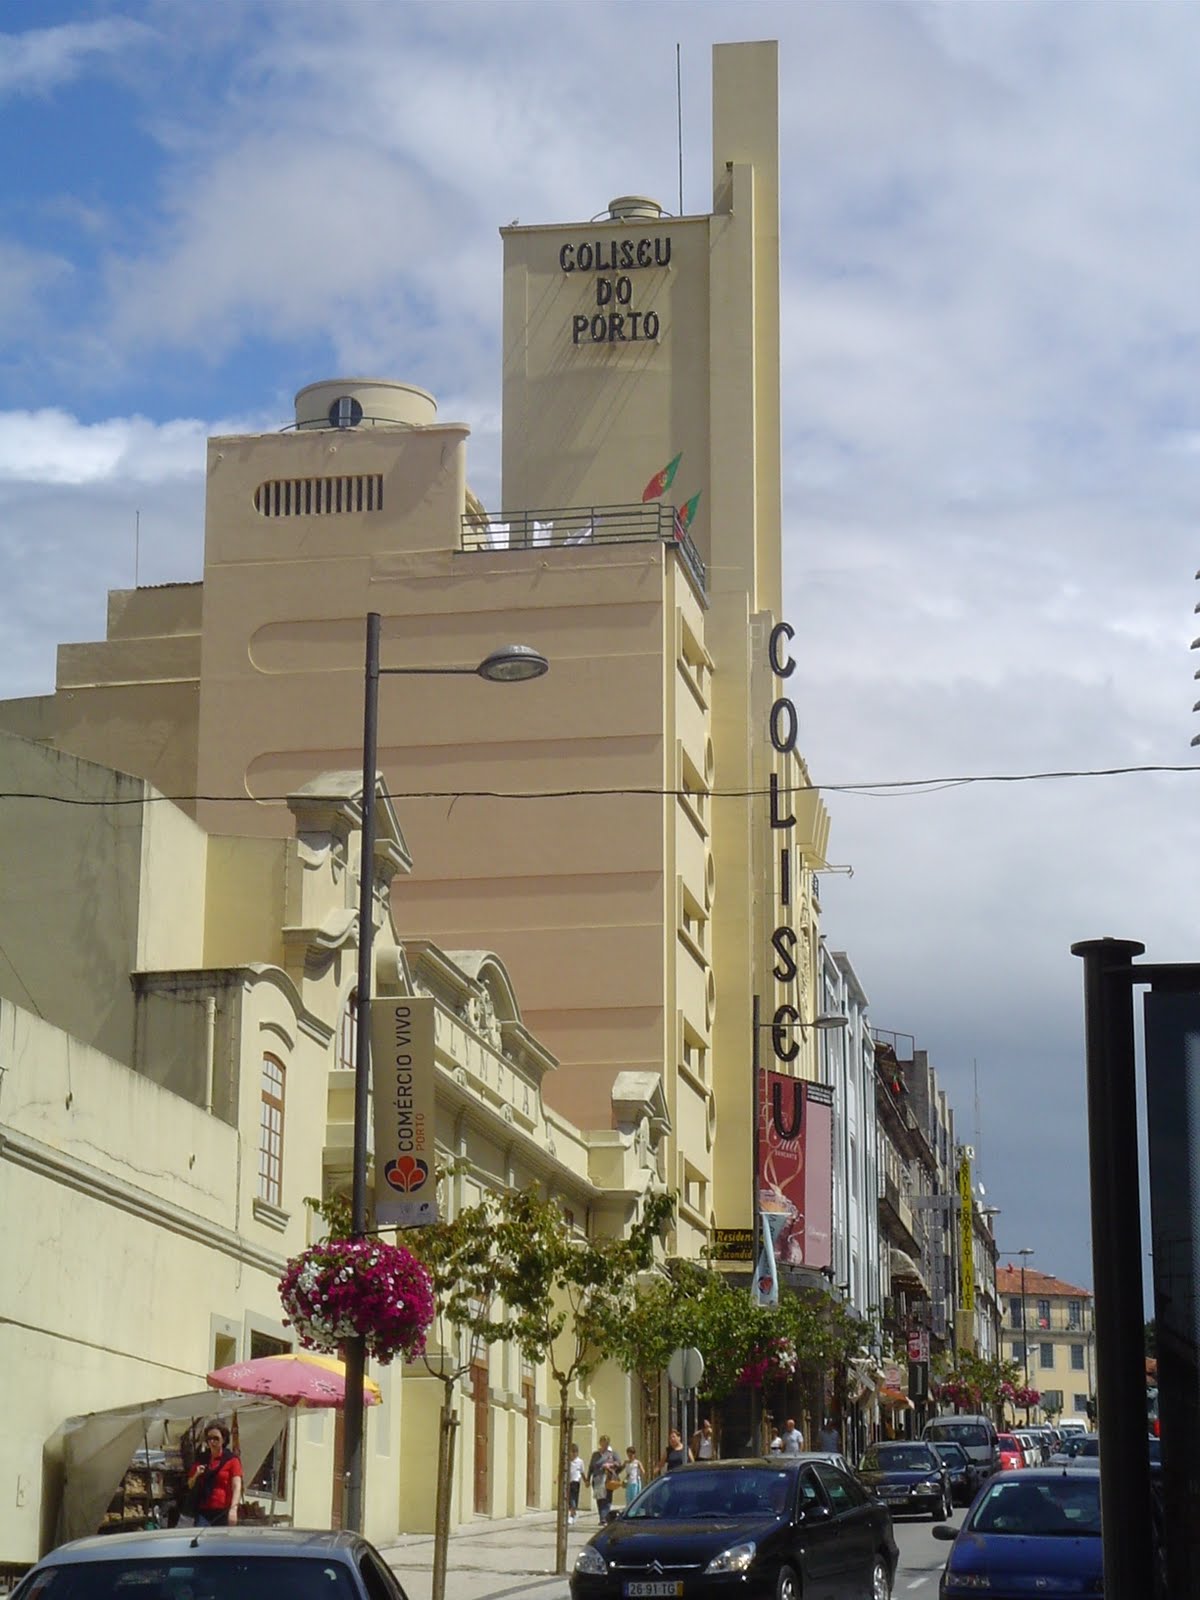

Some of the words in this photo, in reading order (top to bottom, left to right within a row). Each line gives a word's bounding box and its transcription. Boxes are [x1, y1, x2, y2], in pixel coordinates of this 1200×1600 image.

[559, 237, 671, 273] COLISEU
[596, 276, 632, 306] DO
[572, 311, 659, 344] PORTO
[768, 621, 803, 1142] COLISEU
[395, 1006, 412, 1048] VIVO
[392, 1054, 414, 1152] COMÉRCIO
[415, 1112, 425, 1152] PORTO
